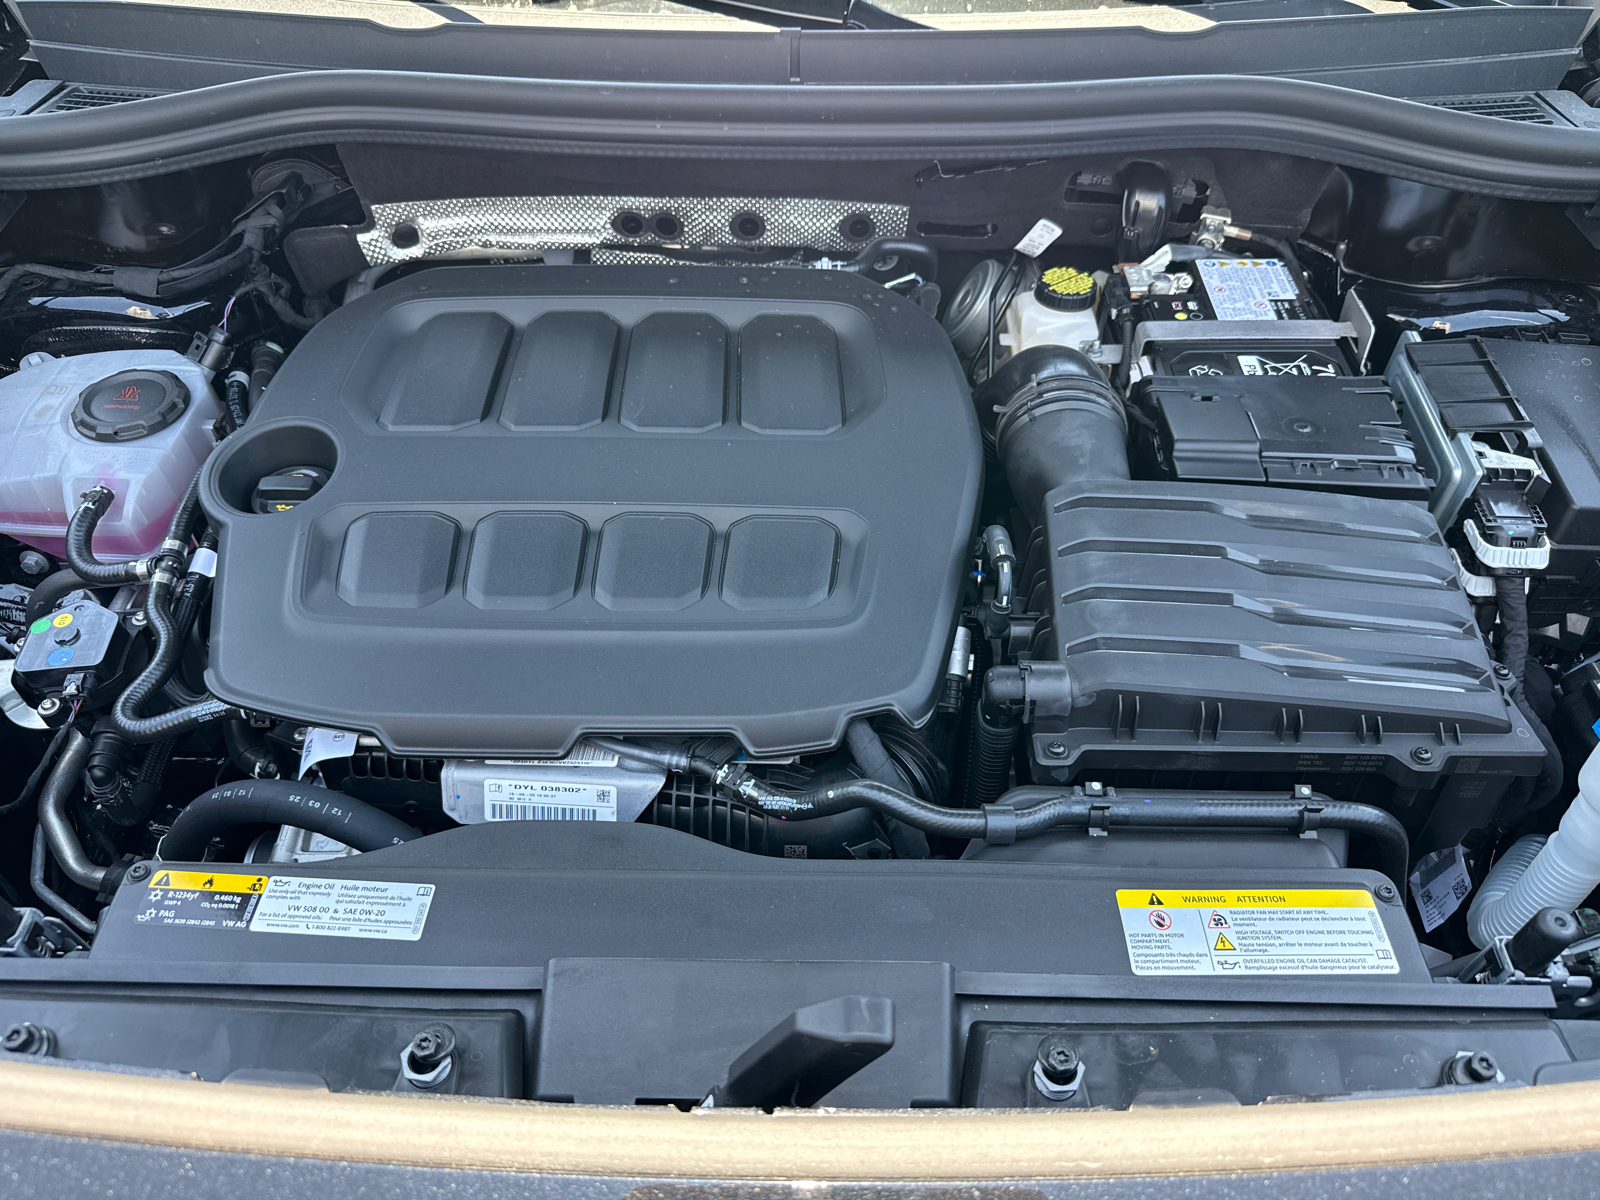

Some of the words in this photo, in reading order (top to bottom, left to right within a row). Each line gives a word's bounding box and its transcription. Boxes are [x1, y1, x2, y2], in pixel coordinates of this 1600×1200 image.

[298, 882, 322, 890] Engine
[167, 890, 199, 899] R-1234yf
[366, 900, 401, 908] expressément
